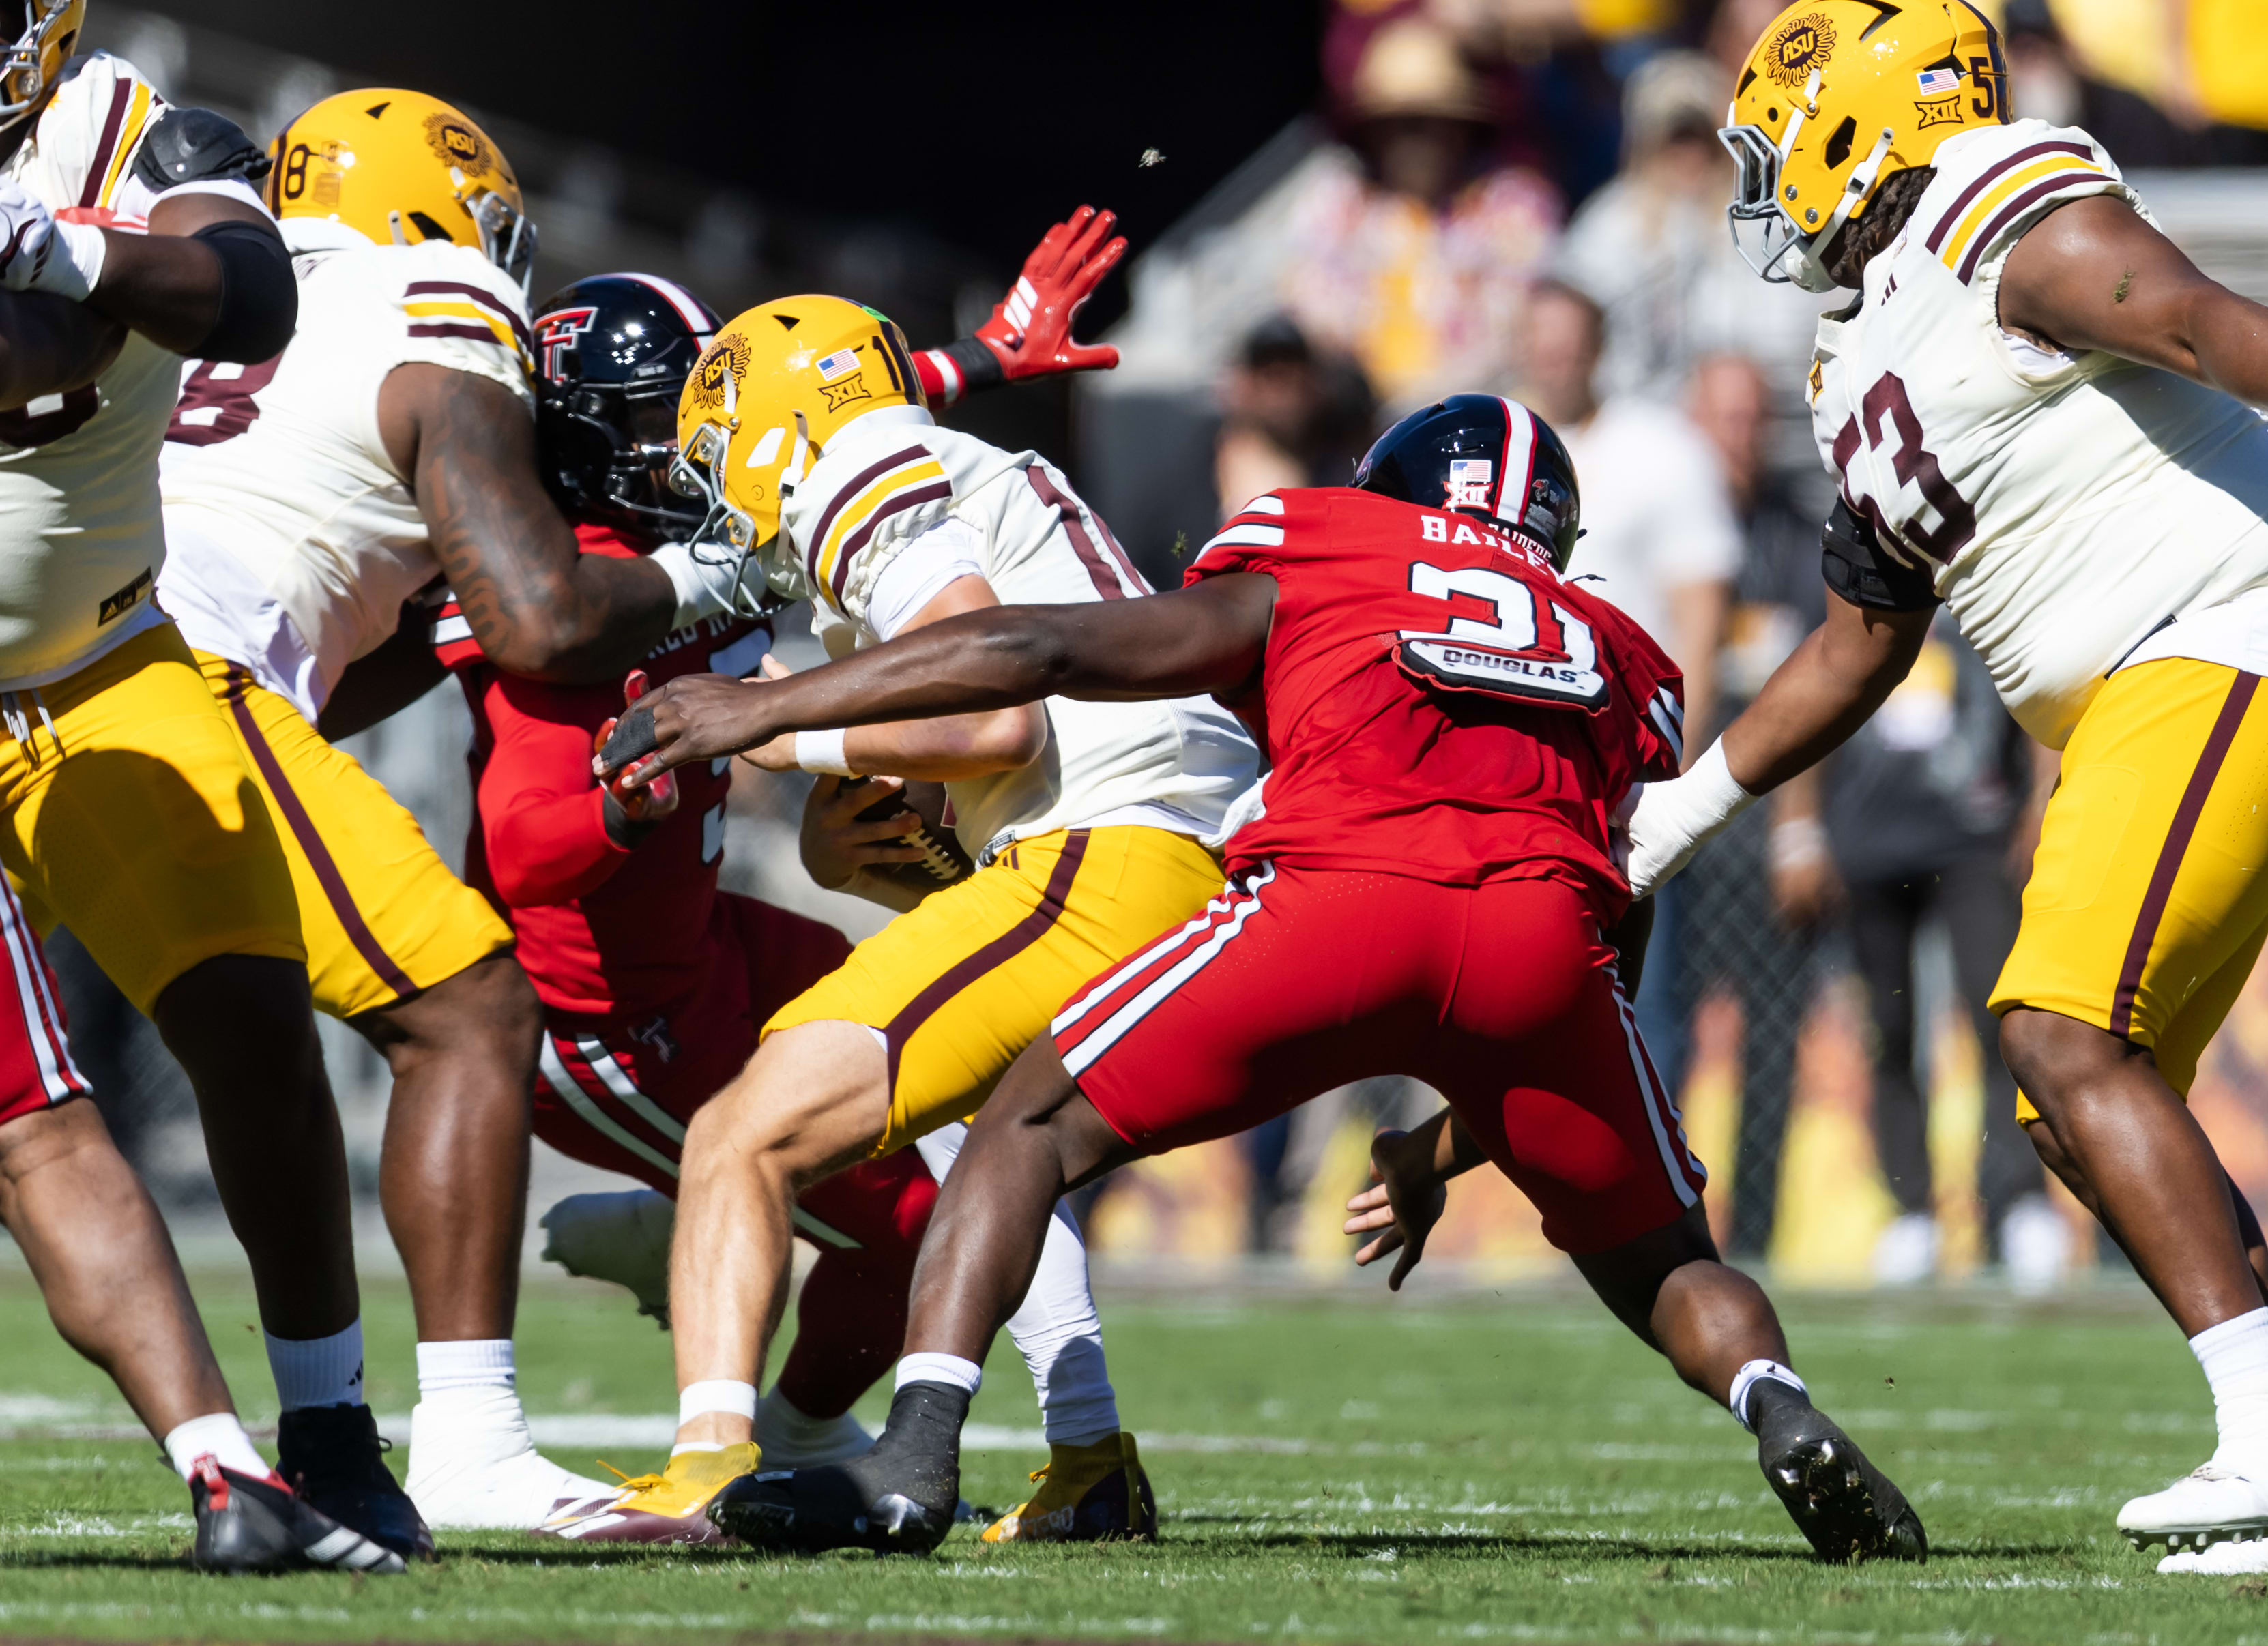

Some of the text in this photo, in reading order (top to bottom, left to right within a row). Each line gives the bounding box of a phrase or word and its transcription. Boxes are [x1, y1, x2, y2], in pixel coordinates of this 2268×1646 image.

[1782, 30, 1815, 64] ASU
[444, 127, 476, 156] ASU
[285, 143, 308, 200] 8
[704, 351, 732, 387] ASU
[1442, 649, 1578, 684] DOUGLAS
